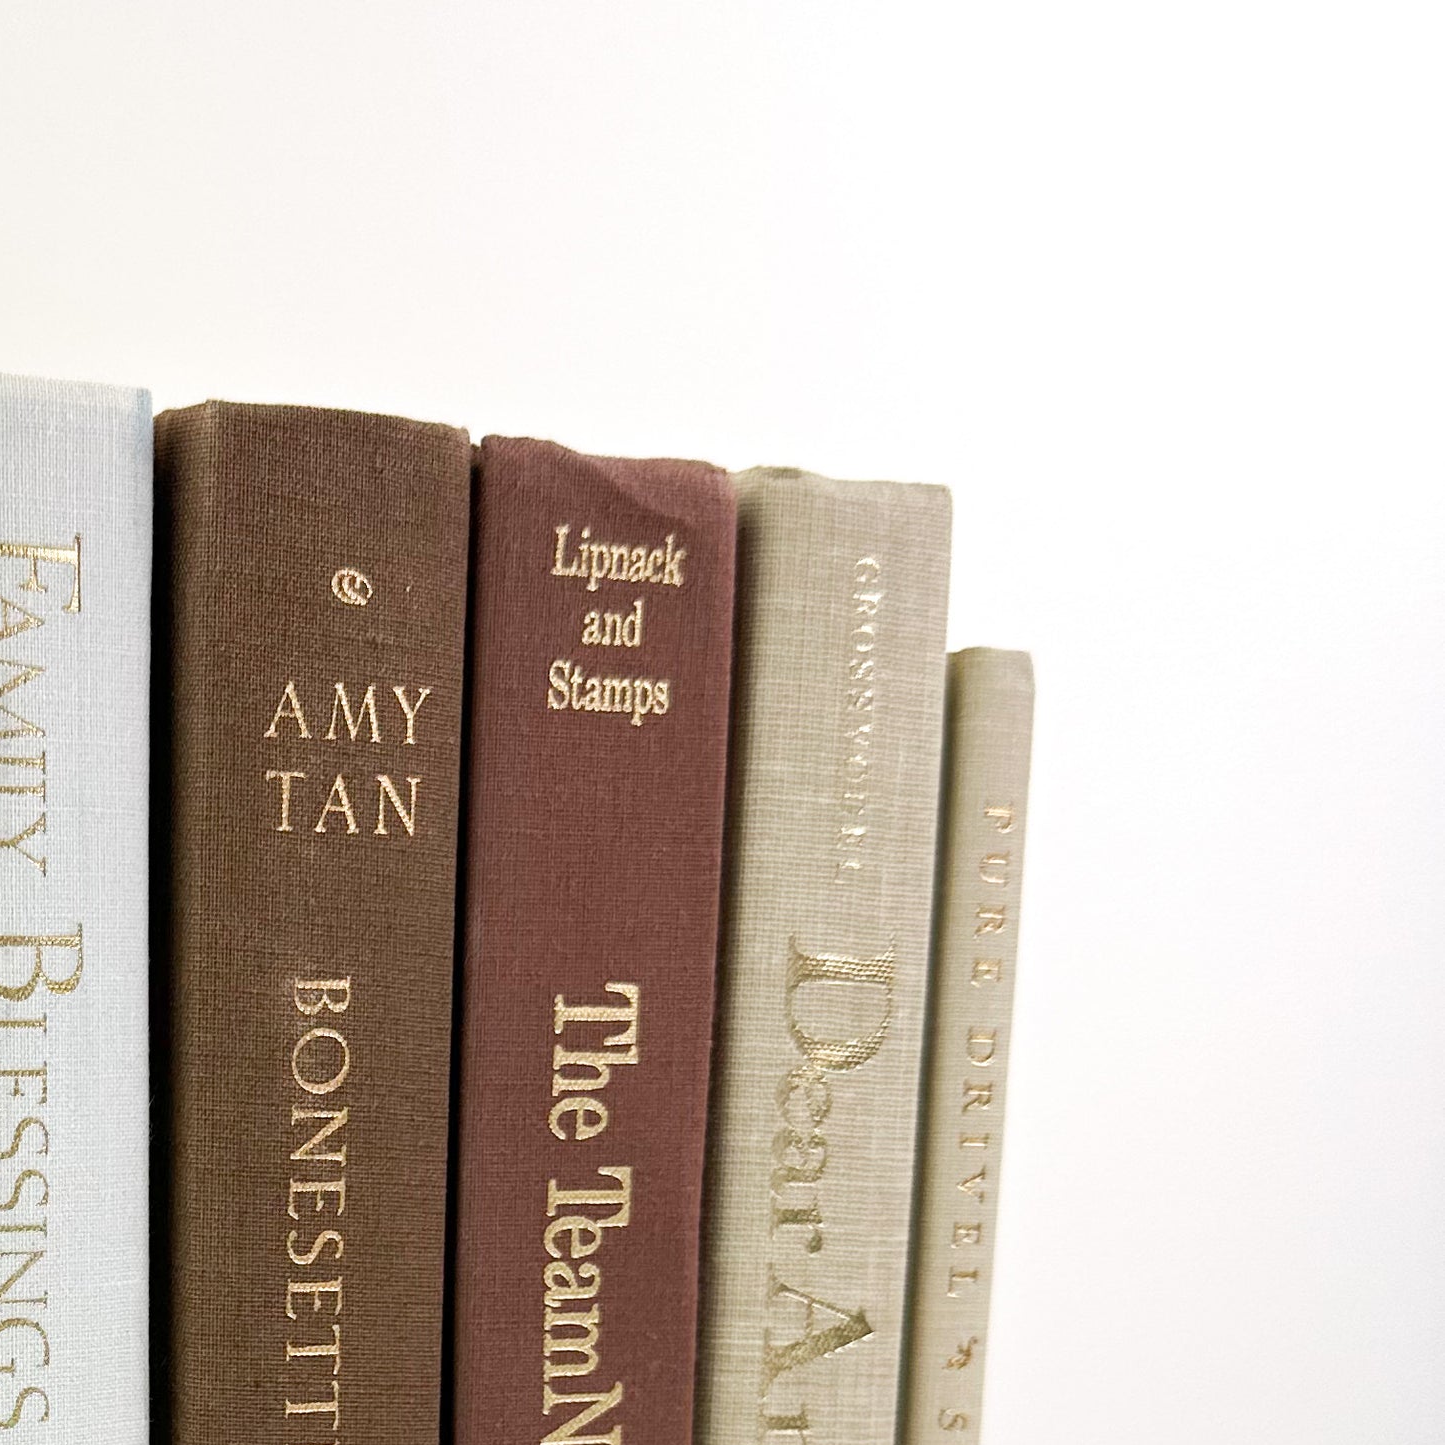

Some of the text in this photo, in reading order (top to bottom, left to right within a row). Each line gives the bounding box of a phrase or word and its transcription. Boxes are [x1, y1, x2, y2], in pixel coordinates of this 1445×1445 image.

[551, 523, 689, 592] Lipnack
[581, 599, 644, 648] and
[263, 680, 433, 745] AMY
[546, 660, 671, 727] Stamps
[265, 769, 421, 837] TAN
[971, 801, 1016, 988] PURE
[547, 981, 642, 1142] The
[768, 932, 897, 1256] Dear
[946, 1023, 998, 1299] DRIVEL
